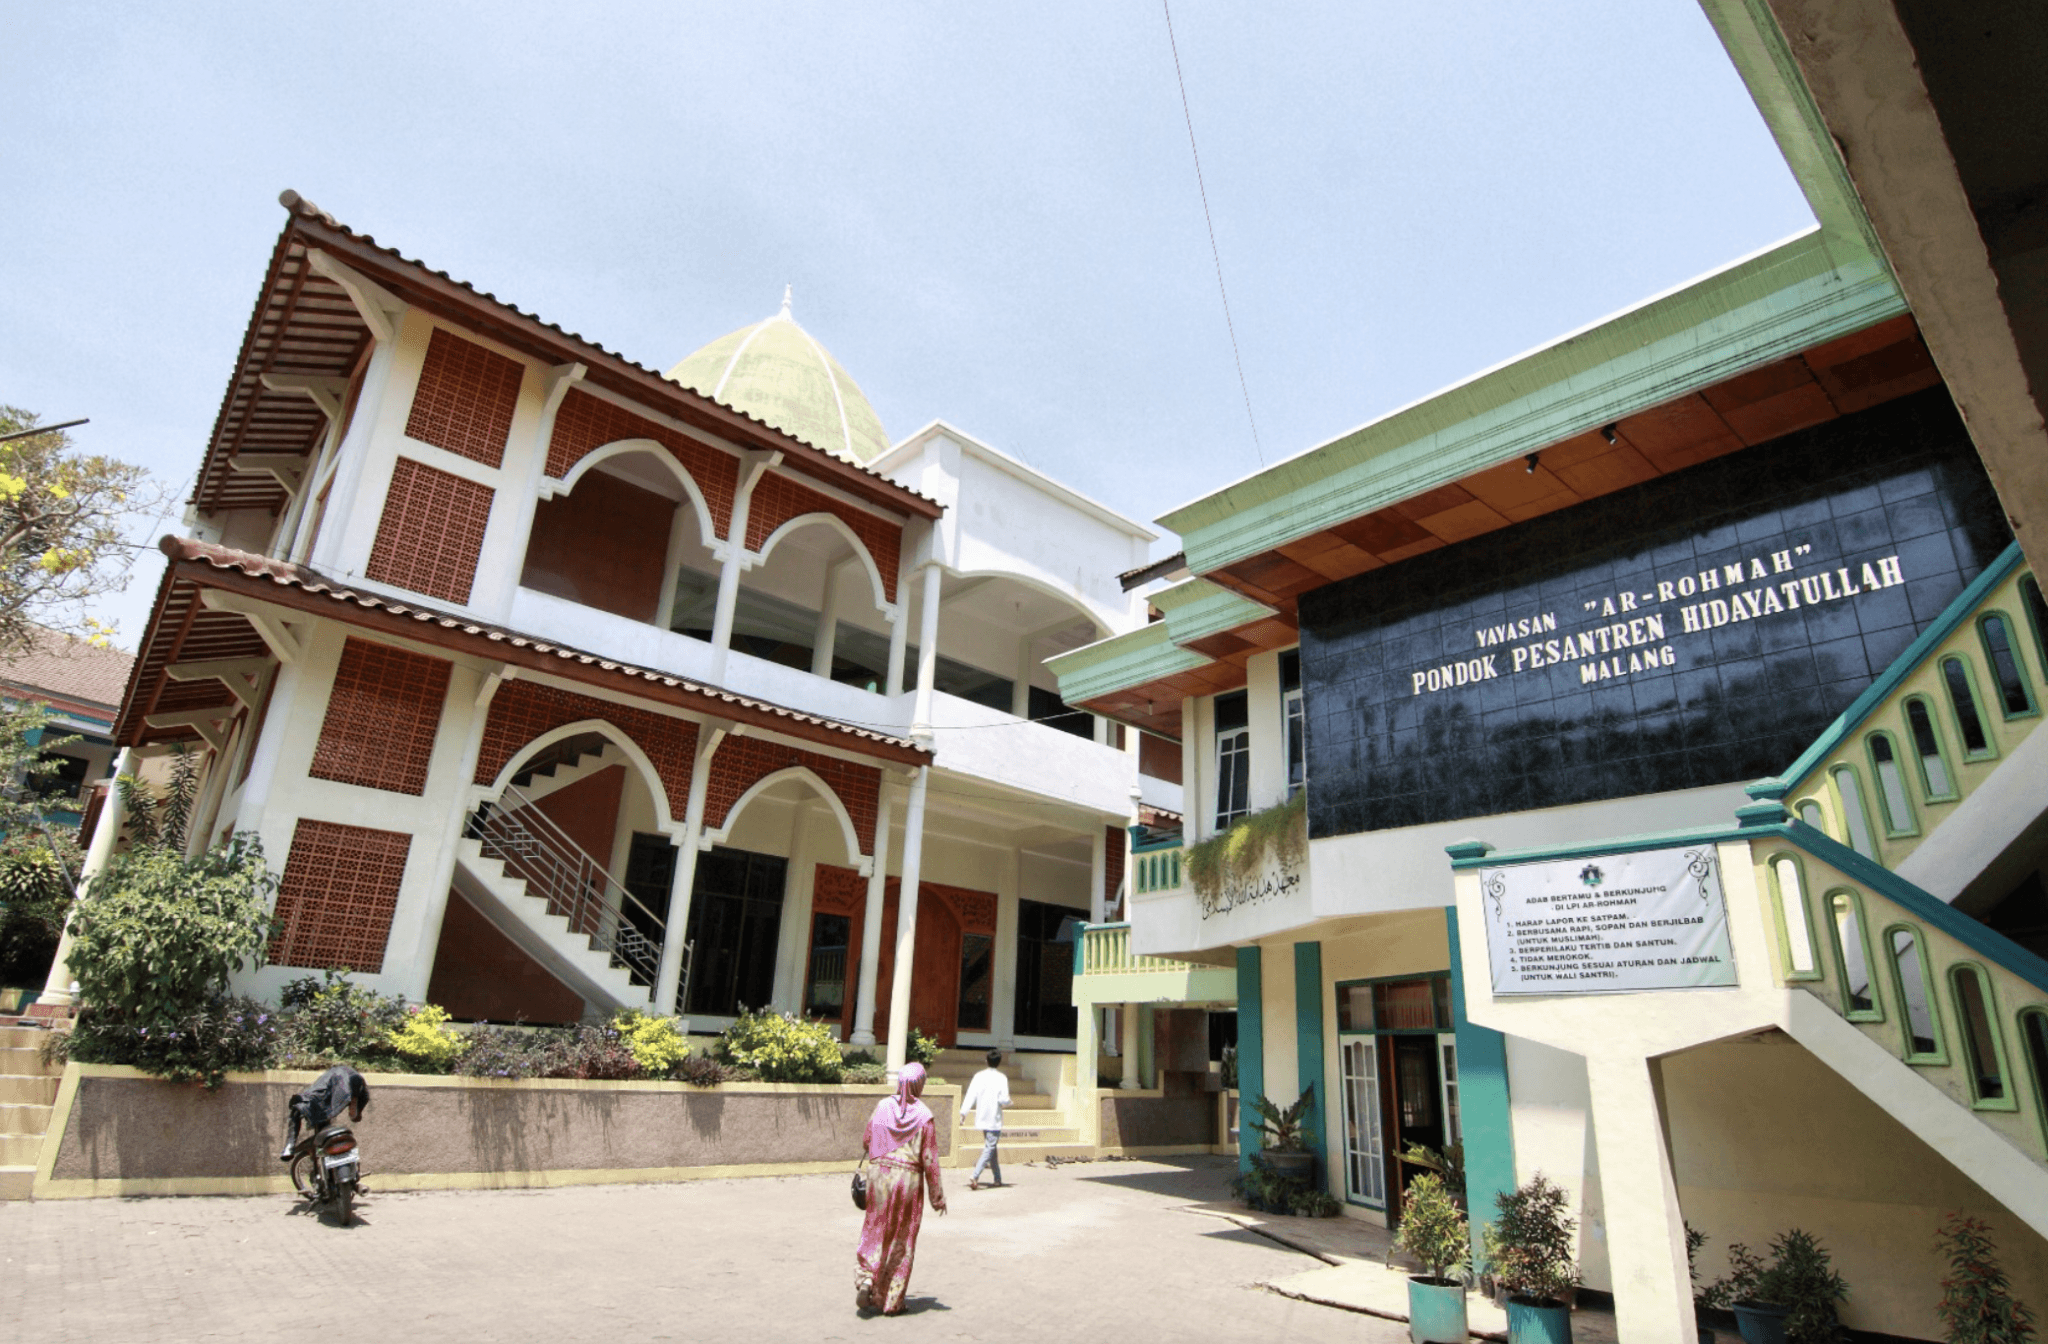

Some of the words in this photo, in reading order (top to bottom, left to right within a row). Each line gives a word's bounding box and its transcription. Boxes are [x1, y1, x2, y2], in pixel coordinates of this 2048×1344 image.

[1412, 654, 1498, 696] PONDOK
[1511, 613, 1666, 673] PESANTREN
[1680, 555, 1905, 634] HIDAYATULLAH
[1476, 612, 1557, 648] YAYASAN
[1580, 645, 1676, 684] MALANG
[1526, 896, 1548, 905] ADAB
[1550, 892, 1592, 902] BERTAMU
[1603, 885, 1667, 898] BERKUNJUNG
[1555, 903, 1563, 911] DI
[1566, 902, 1580, 910] LPI
[1582, 898, 1637, 909] AR-ROHMAH
[1515, 919, 1543, 928] HARAP
[1546, 917, 1574, 926] LAPOR
[1576, 915, 1588, 923] KE
[1591, 912, 1629, 923] SATPAM.
[1516, 926, 1568, 937] BERBUSANA
[1595, 922, 1626, 931] SOPAN
[1629, 920, 1648, 929] DAN
[1651, 916, 1704, 928] BERJILBAB
[1517, 936, 1548, 946] (UNTUK
[1519, 944, 1577, 954] BERPERILAKU
[1580, 941, 1611, 951] TERTIB
[1613, 940, 1633, 950] DAN
[1635, 937, 1678, 948] SANTUN.
[1519, 954, 1544, 963] TIDAK
[1546, 952, 1594, 962] MEROKOK.
[1521, 962, 1579, 973] BERKUNJUNG
[1582, 960, 1614, 970] SESUAI
[1617, 958, 1654, 968] ATURAN
[1657, 957, 1677, 966] DAN
[1680, 955, 1721, 965] JADWAL
[1555, 972, 1577, 980] WALI
